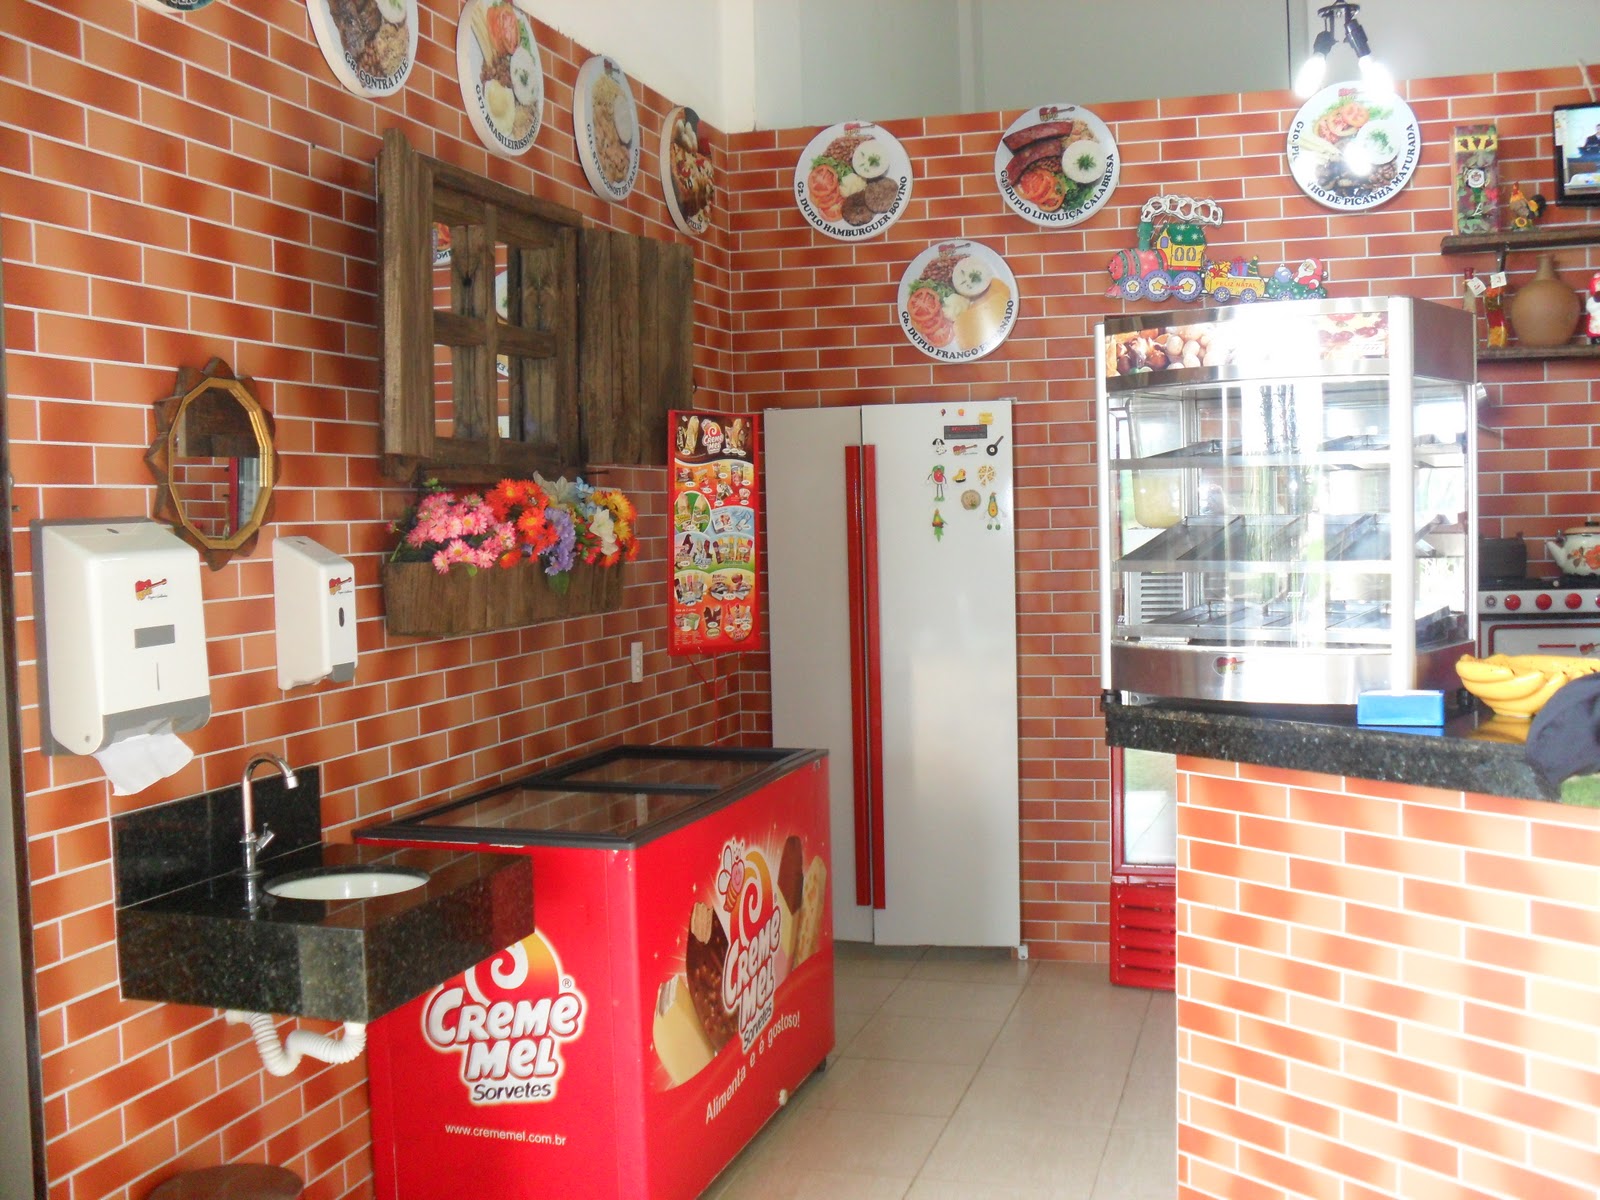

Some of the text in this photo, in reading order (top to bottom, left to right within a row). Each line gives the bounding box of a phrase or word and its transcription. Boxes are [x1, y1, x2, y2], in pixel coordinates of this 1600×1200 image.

[359, 69, 395, 90] CONTRA
[1005, 186, 1031, 214] DUPLO
[1032, 208, 1084, 222] LINGUIÇA
[1083, 153, 1114, 211] CALABRESA
[1325, 192, 1342, 205] DE
[1343, 185, 1394, 206] PICANHA
[1391, 123, 1416, 188] MATURADA
[799, 197, 824, 227] DUPLO
[823, 213, 891, 237] HAMBURGUER
[889, 175, 908, 216] BOVINO
[1235, 281, 1258, 289] NATAL
[907, 327, 935, 354] DUPLO
[935, 347, 979, 360] FRANGO
[726, 906, 781, 1011] CREME
[427, 986, 581, 1047] CREME
[740, 956, 775, 1033] MEL
[743, 1001, 772, 1051] Sorvetes
[466, 1037, 559, 1082] MEL
[705, 1010, 800, 1125] Alimenta e é gostoso!
[472, 1082, 552, 1102] Sorvetes
[444, 1123, 567, 1147] www.crememel.com.br
